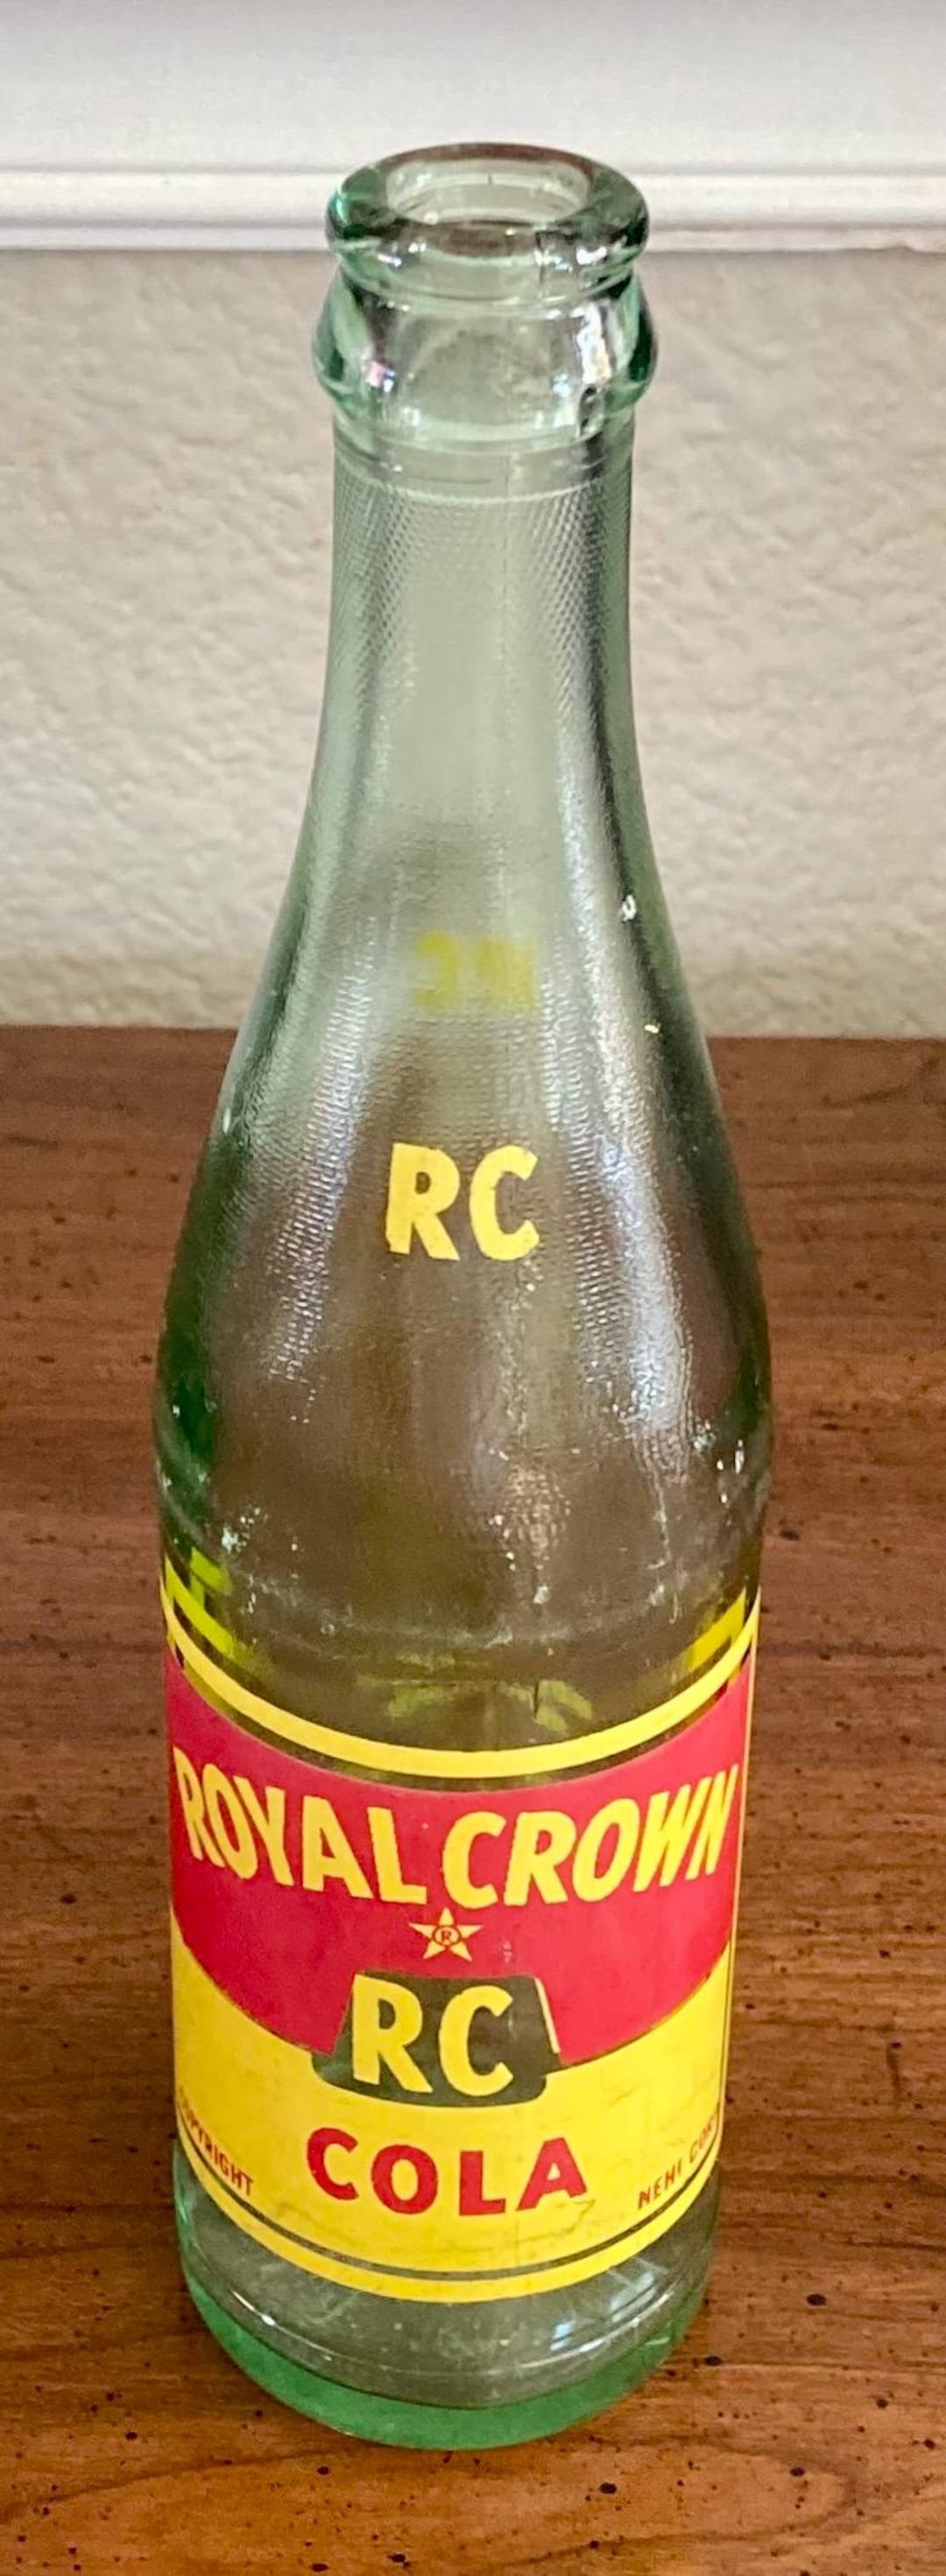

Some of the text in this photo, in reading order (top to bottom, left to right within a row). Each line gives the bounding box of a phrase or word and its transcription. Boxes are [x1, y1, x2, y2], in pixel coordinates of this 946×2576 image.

[385, 1143, 540, 1261] RC
[173, 1746, 739, 1909] ROYAL CROWN
[351, 1974, 514, 2096] RC
[307, 2127, 587, 2216] COLA
[638, 2157, 682, 2210] NEHI
